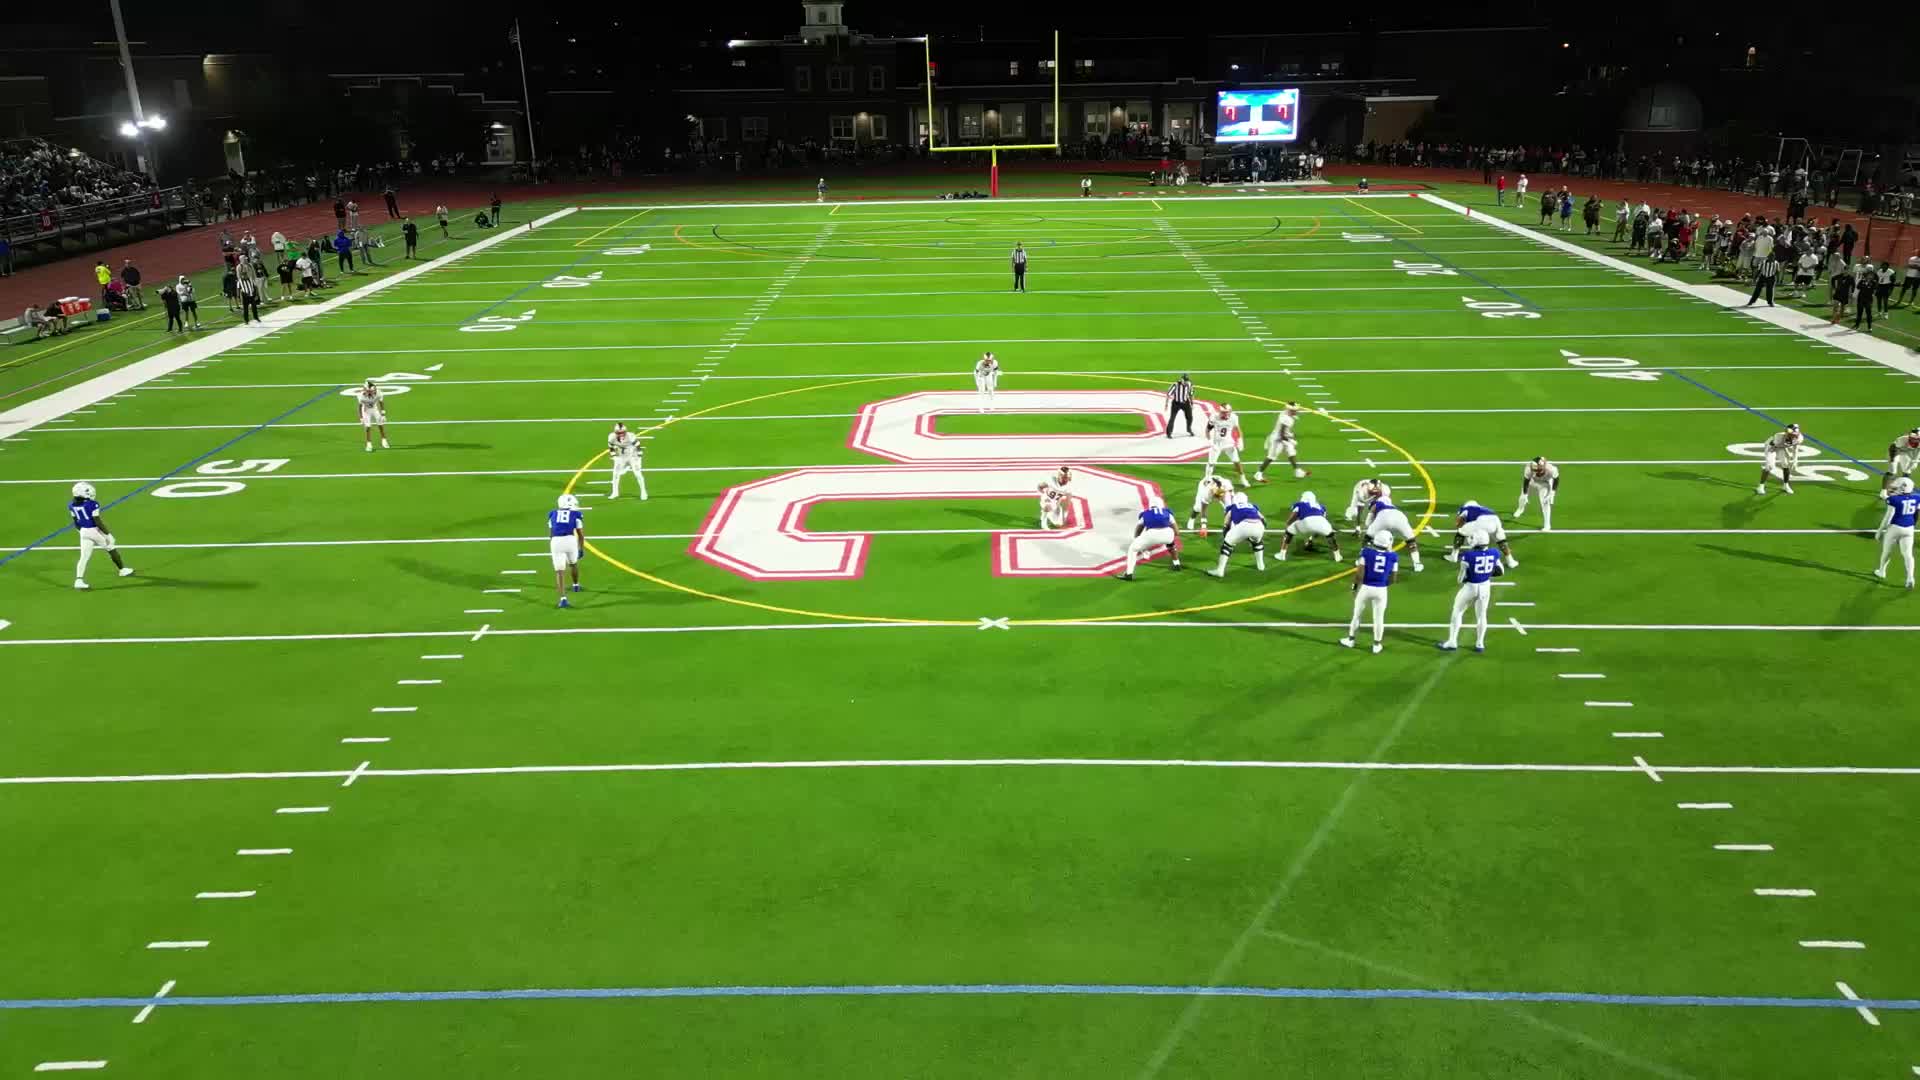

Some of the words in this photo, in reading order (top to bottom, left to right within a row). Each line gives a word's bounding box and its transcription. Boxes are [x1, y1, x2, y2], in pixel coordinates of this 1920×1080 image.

[1394, 263, 1459, 276] 20
[1465, 302, 1542, 319] 30
[459, 313, 533, 332] 30
[1568, 357, 1662, 381] 40
[339, 372, 432, 396] 40
[1220, 428, 1227, 437] 9
[1726, 442, 1869, 481] 50
[151, 459, 291, 497] 50
[1049, 491, 1063, 500] 97
[73, 506, 89, 520] 17
[1902, 499, 1916, 515] 16
[556, 510, 571, 523] 18
[1374, 556, 1386, 573] 2
[1474, 555, 1495, 574] 26
